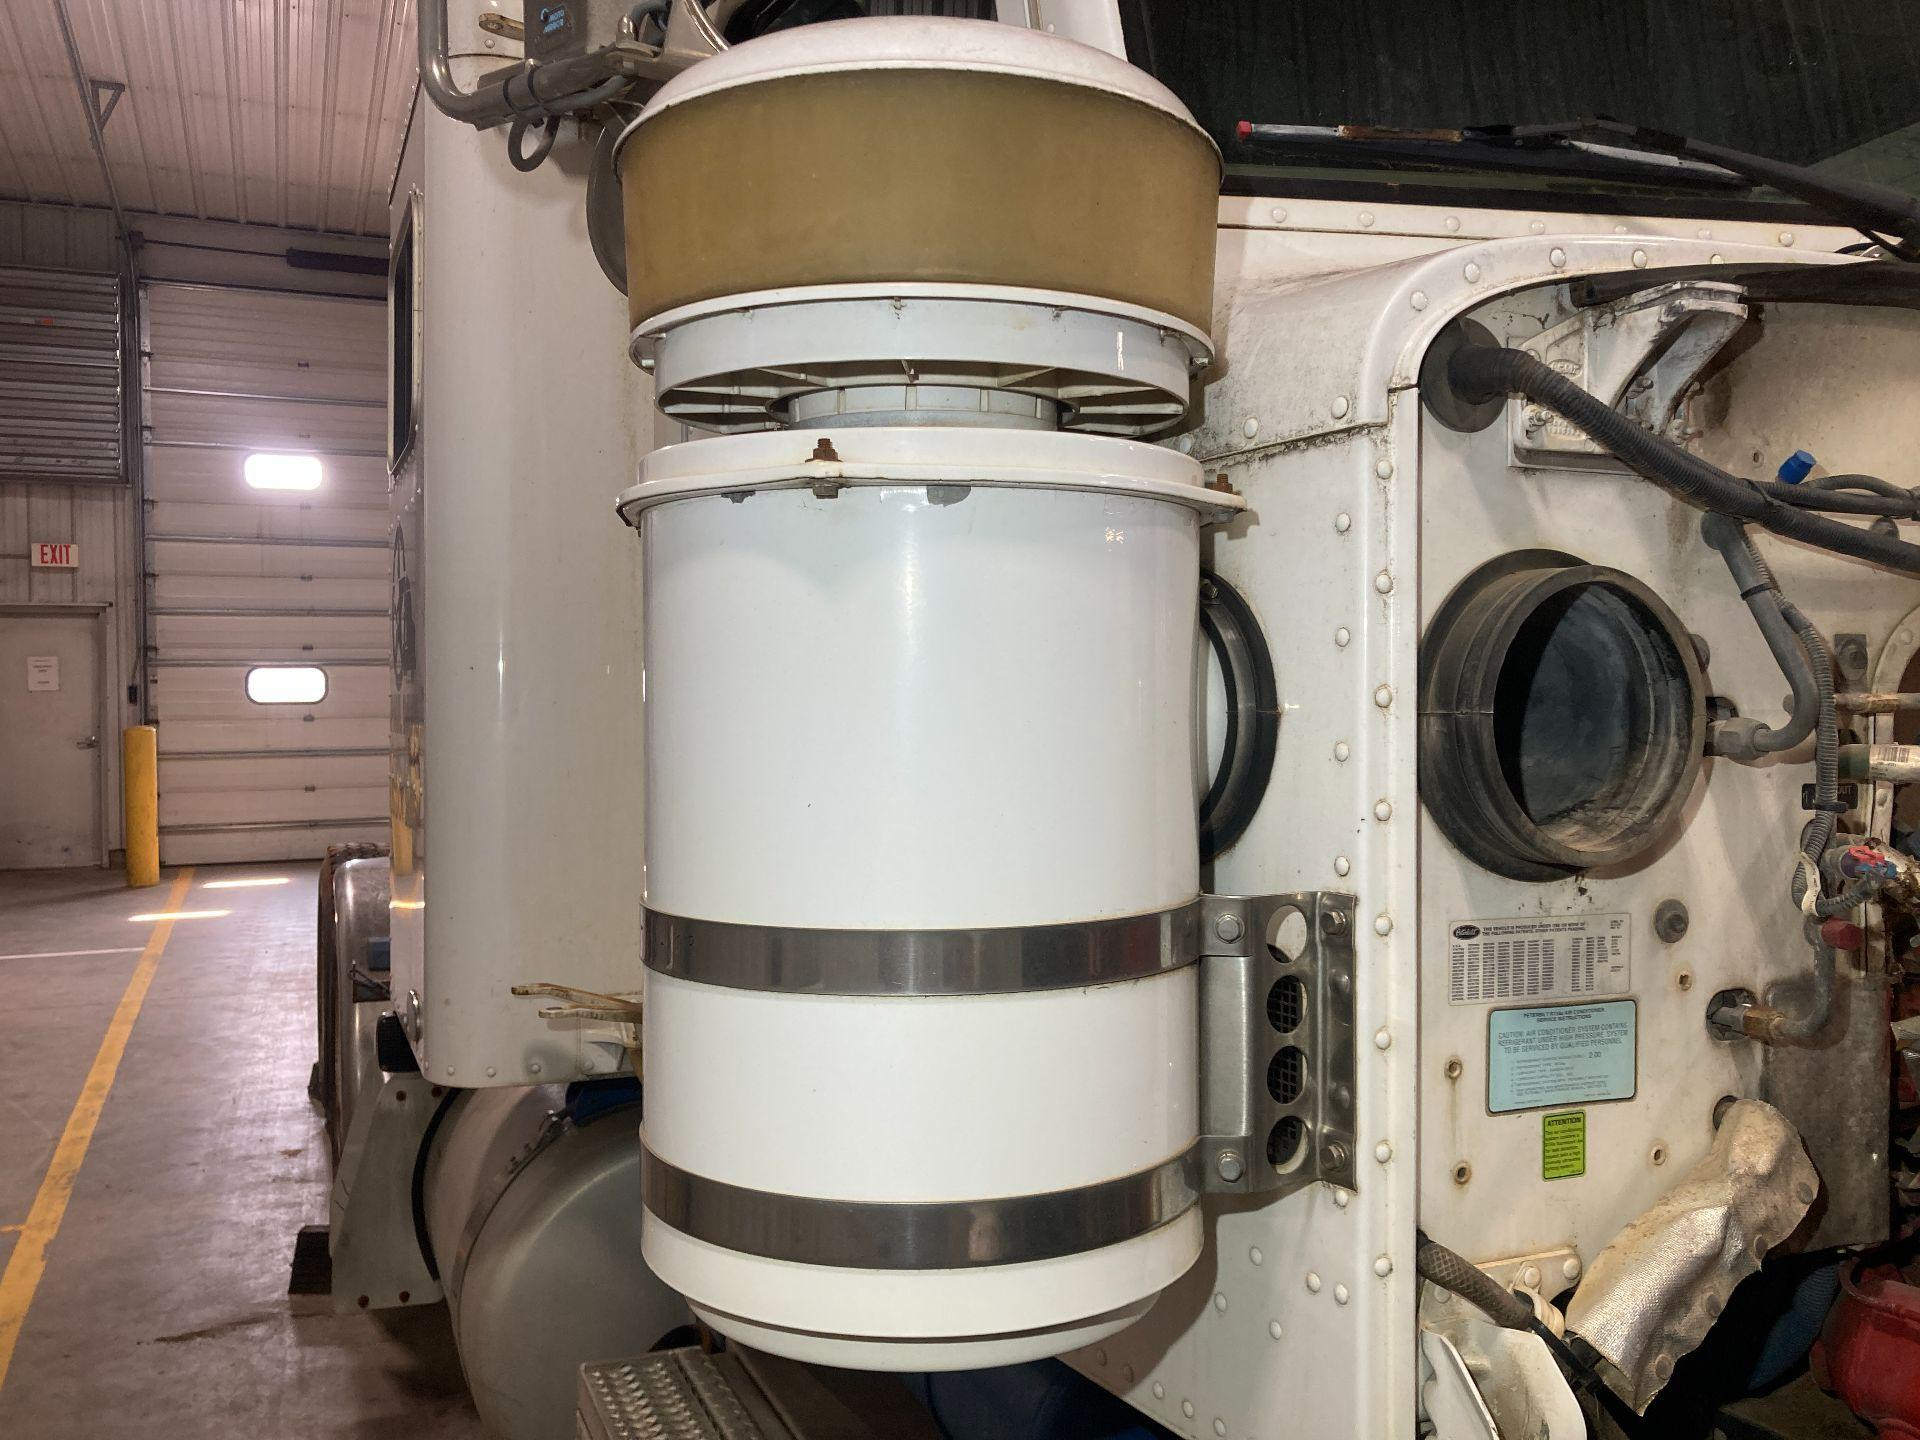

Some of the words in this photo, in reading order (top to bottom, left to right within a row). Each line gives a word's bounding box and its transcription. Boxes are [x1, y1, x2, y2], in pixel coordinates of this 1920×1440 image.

[40, 544, 71, 564] EXIT
[1537, 1027, 1575, 1036] CONDITIONER
[1600, 1023, 1628, 1031] CONTAINS
[1497, 1037, 1536, 1046] REFRIGERANT
[1537, 1035, 1557, 1043] UNDER
[1521, 1044, 1549, 1052] SERVICED
[1559, 1040, 1589, 1049] QUALIFIED
[1548, 1117, 1581, 1126] ATTENTION
